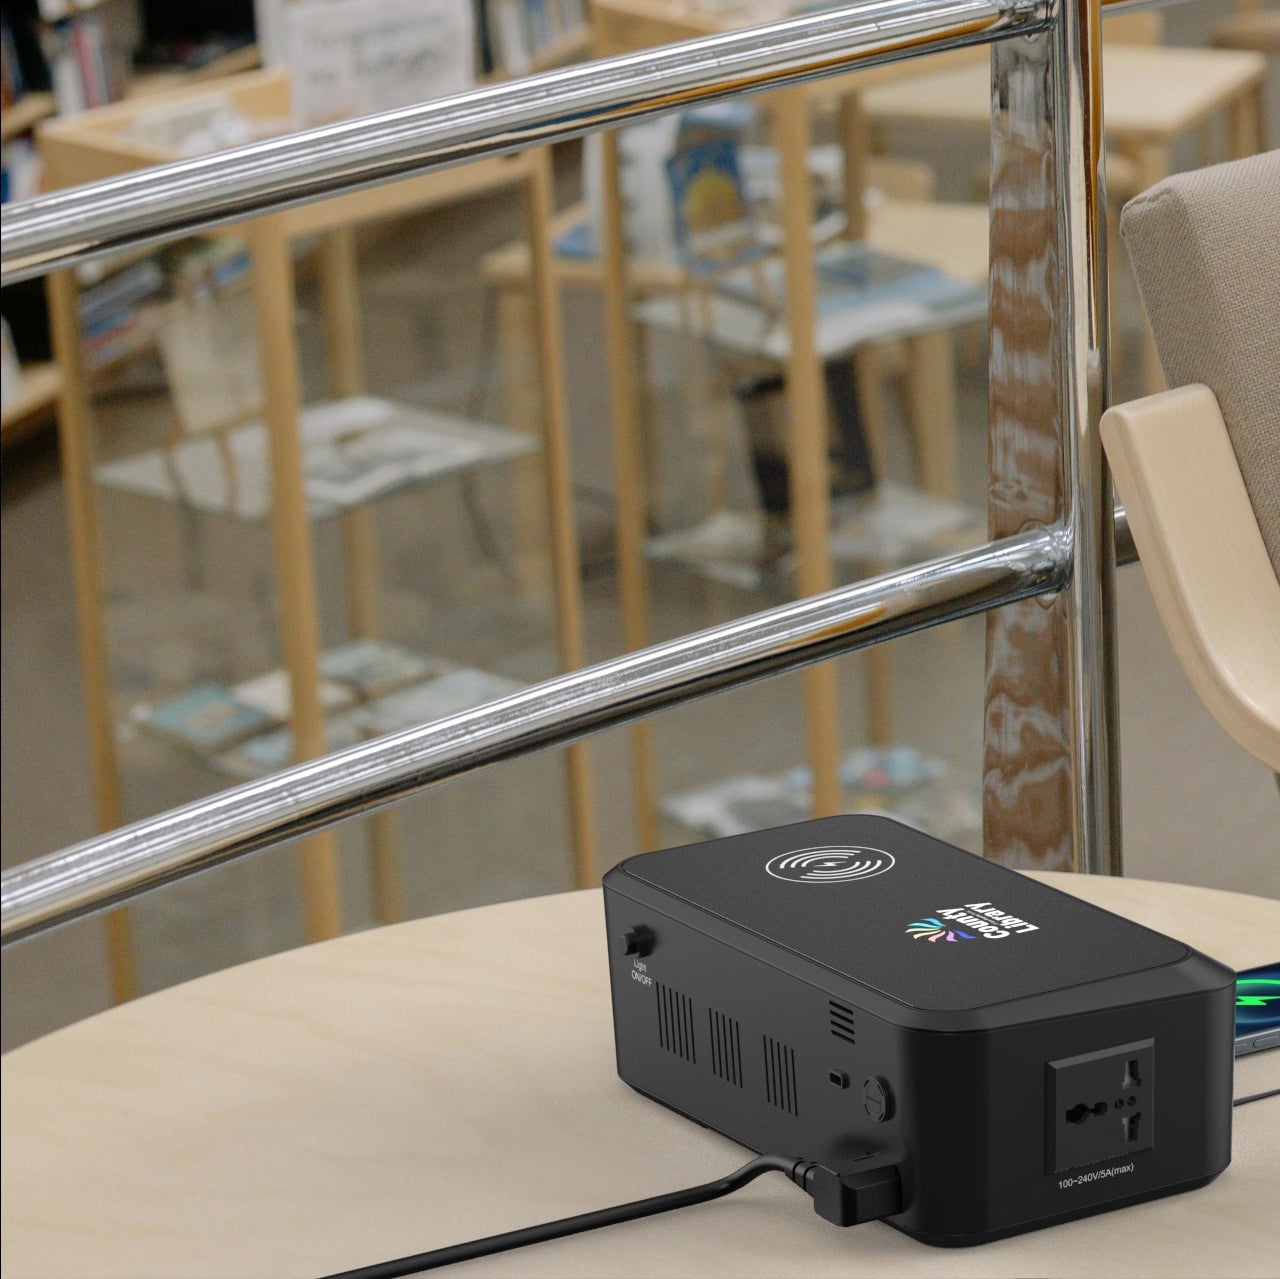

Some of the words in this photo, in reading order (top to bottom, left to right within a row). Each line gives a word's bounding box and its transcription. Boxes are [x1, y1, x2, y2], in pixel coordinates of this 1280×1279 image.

[936, 907, 1010, 939] County
[964, 902, 1040, 934] Library
[631, 969, 652, 987] ON/OFF
[633, 959, 647, 972] Light
